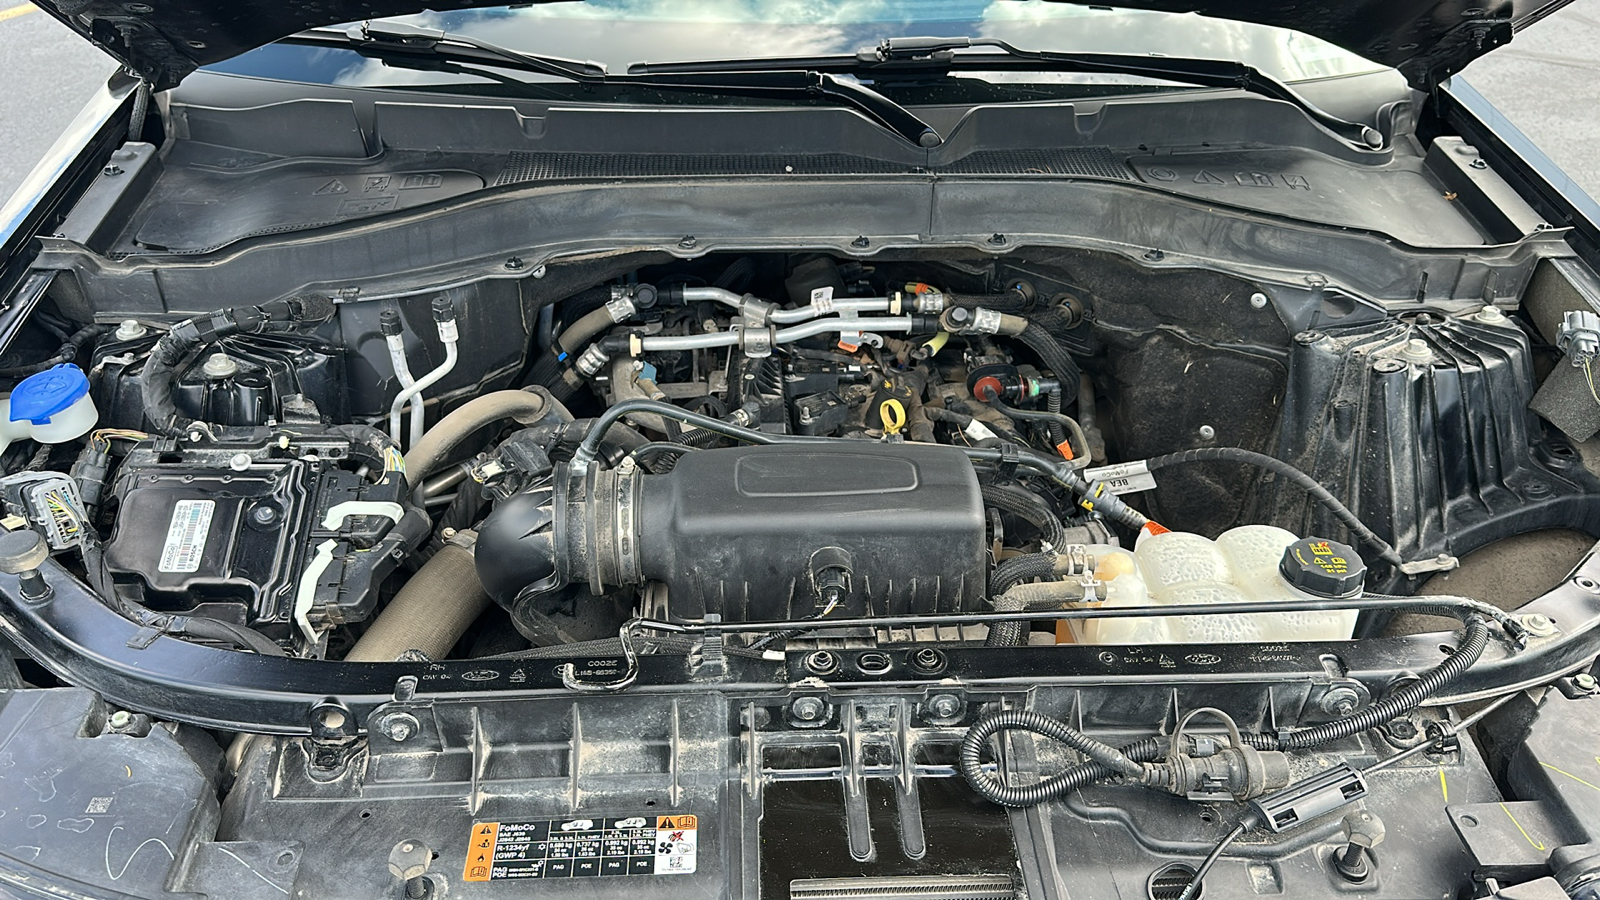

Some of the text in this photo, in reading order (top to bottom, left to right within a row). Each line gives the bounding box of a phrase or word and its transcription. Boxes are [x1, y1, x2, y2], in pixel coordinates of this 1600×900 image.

[1102, 469, 1129, 478] FoMoCo
[1110, 478, 1129, 488] BEA
[189, 544, 198, 562] BOSCH
